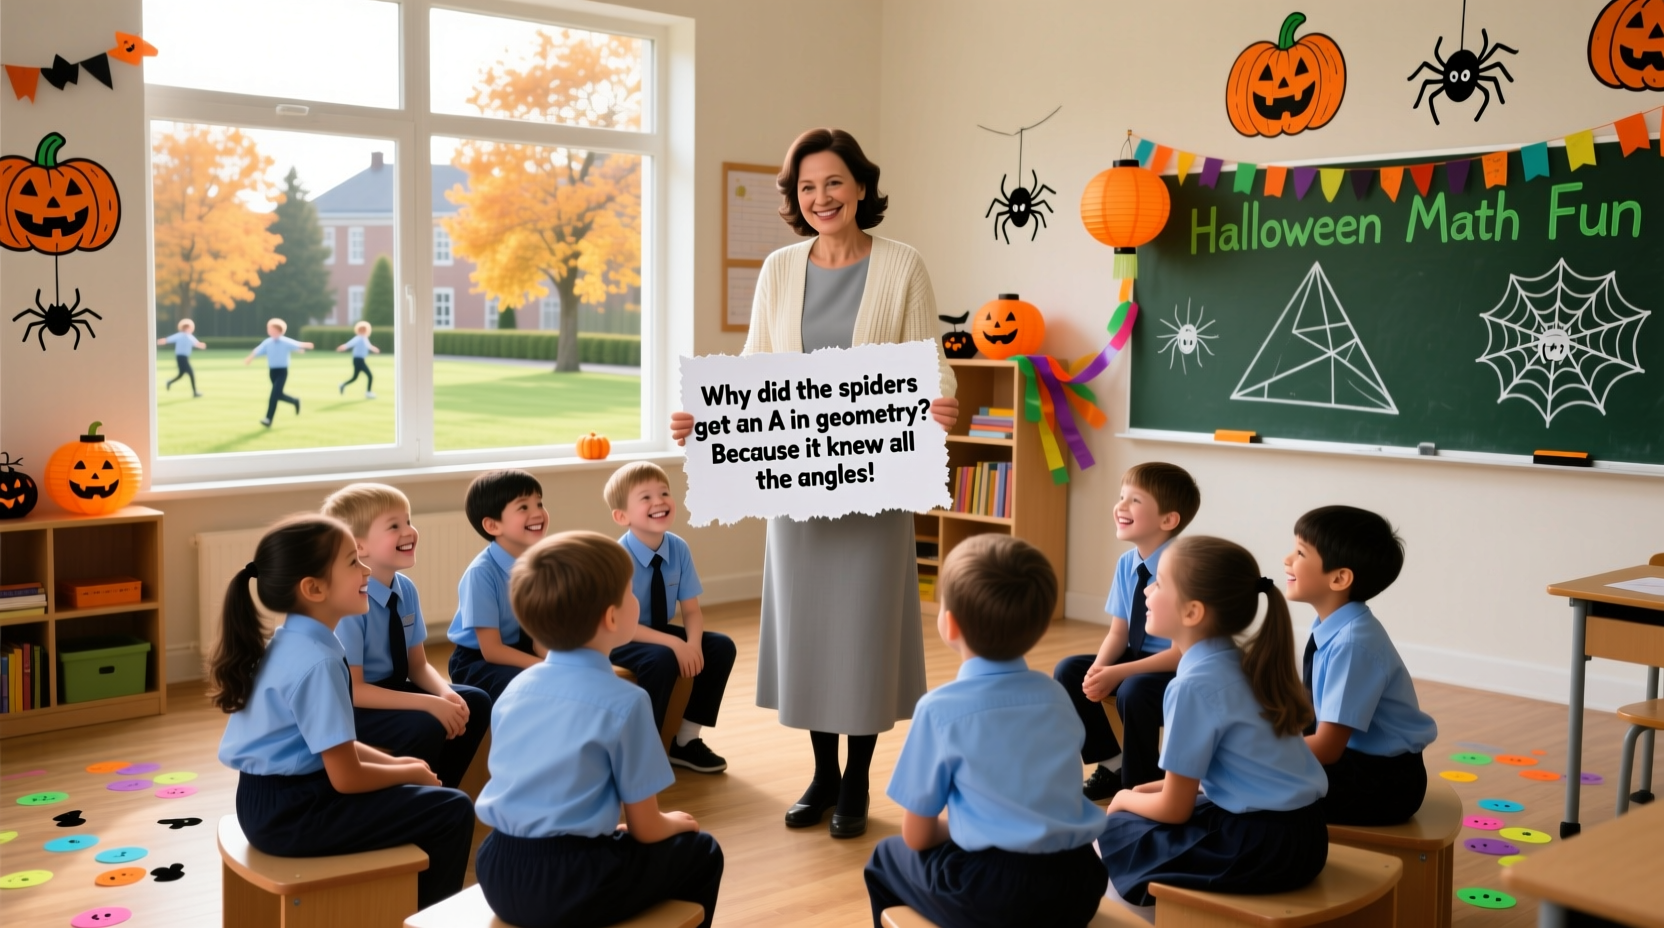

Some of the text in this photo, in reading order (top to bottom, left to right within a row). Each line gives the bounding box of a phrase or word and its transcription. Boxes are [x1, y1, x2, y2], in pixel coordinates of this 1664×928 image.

[1190, 182, 1641, 254] Halloween Math Fun
[701, 373, 917, 410] Why did the spiders
[695, 399, 930, 441] get an A in geometry?
[712, 431, 914, 464] Because it knew all
[756, 462, 874, 490] the angles!
